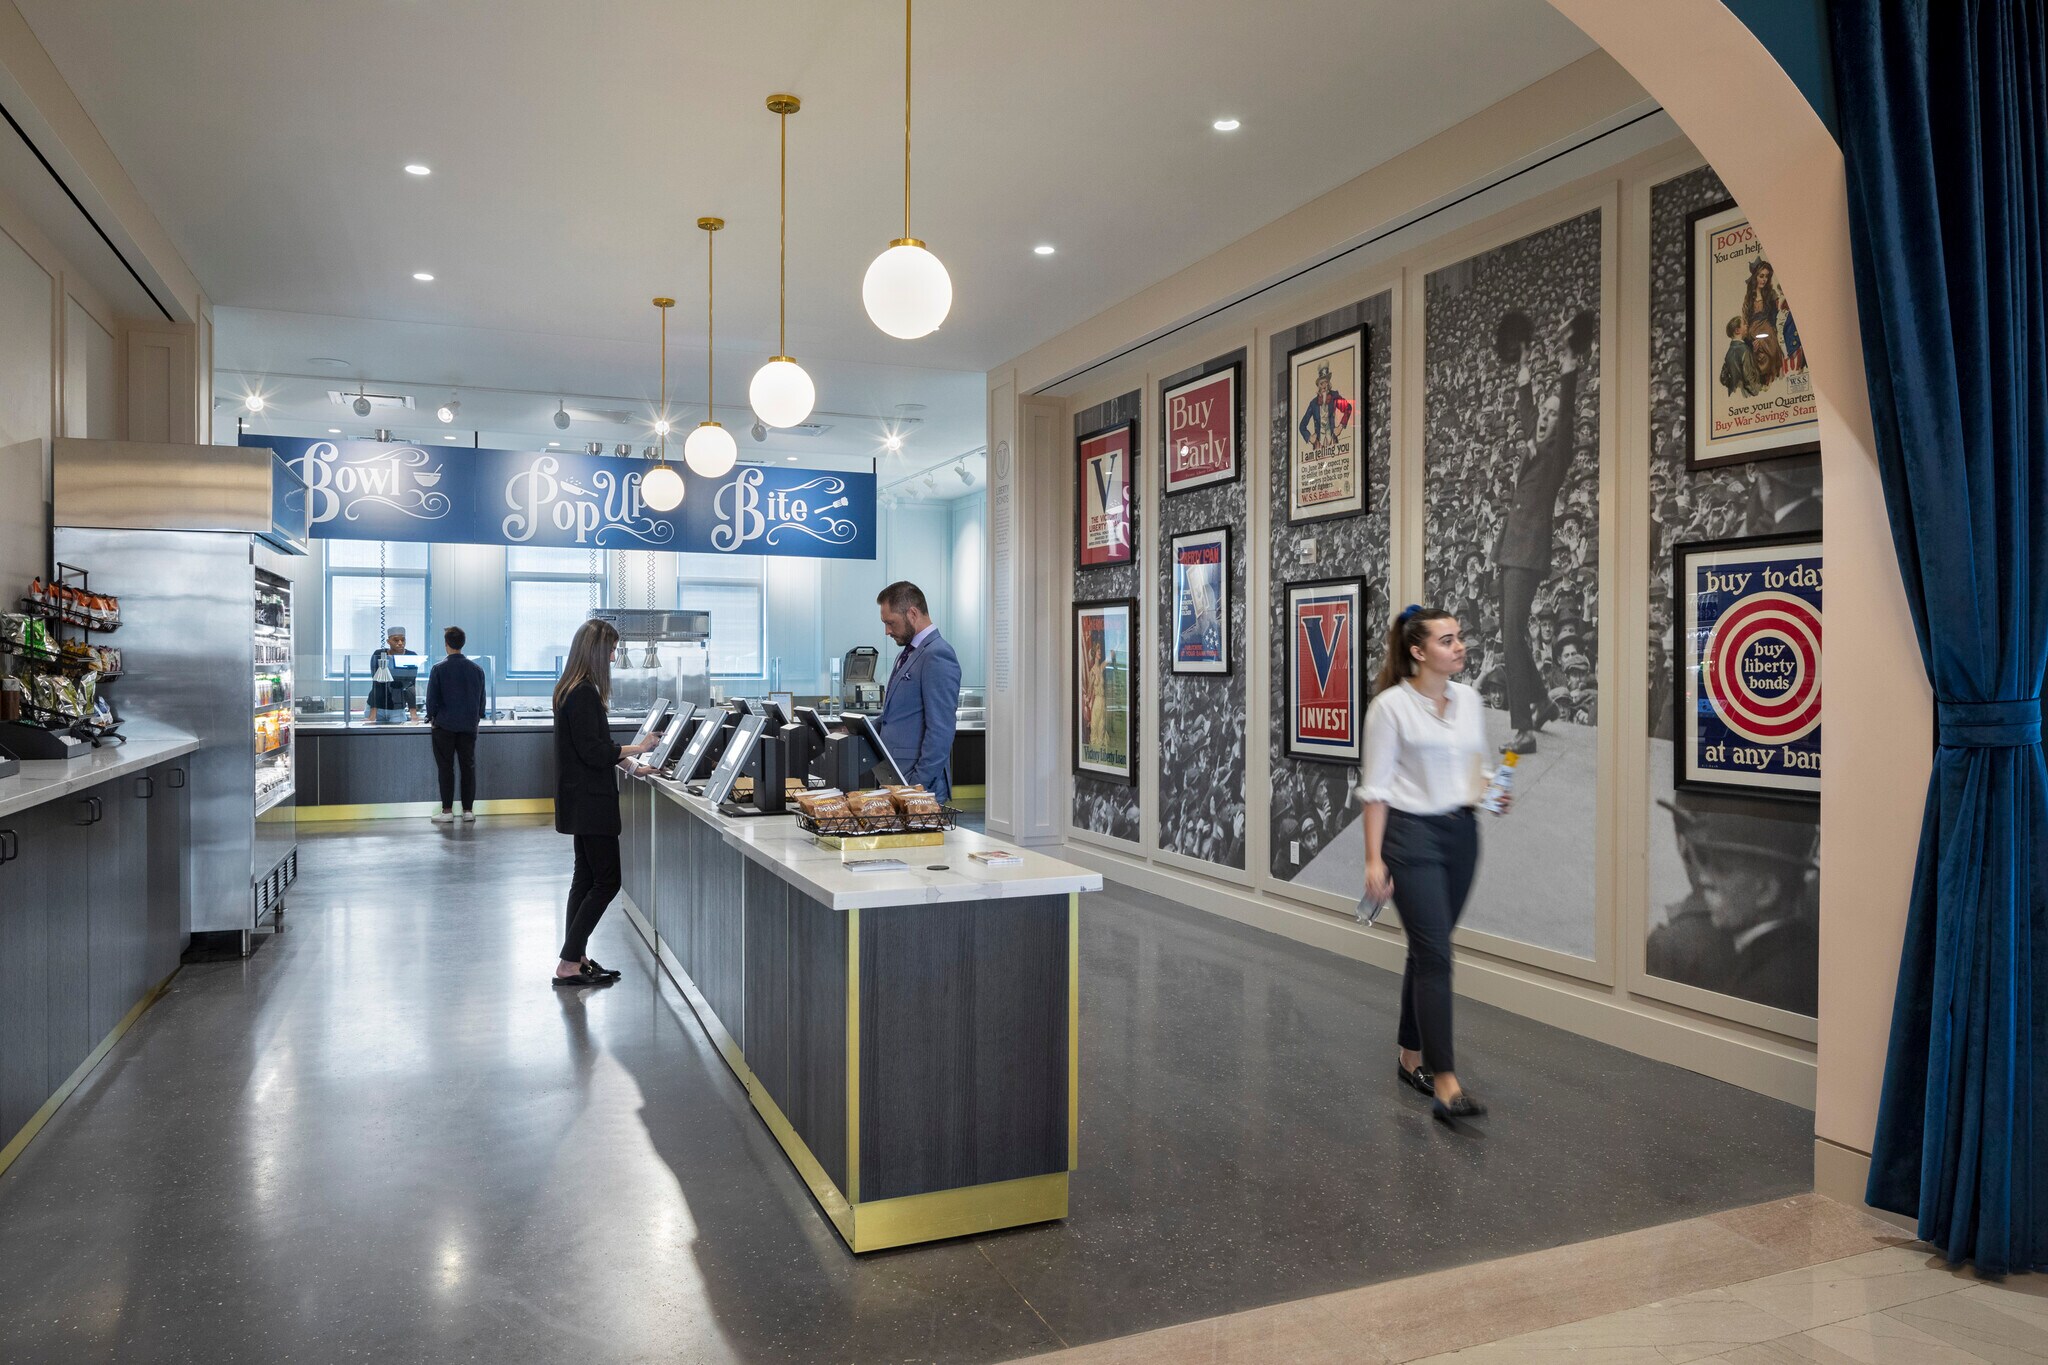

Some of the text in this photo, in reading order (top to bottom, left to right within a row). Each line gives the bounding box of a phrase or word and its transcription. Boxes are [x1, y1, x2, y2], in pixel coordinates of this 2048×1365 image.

[1714, 252, 1729, 264] You
[1730, 249, 1744, 259] can
[1172, 396, 1215, 431] Buy
[1728, 393, 1815, 417] Save your Quarters
[1715, 420, 1733, 432] Buy
[1734, 416, 1753, 427] War
[1754, 410, 1789, 424] Savings
[1175, 429, 1227, 472] Early
[1305, 450, 1314, 461] am
[1315, 445, 1336, 461] telling
[1337, 443, 1349, 456] you
[1331, 466, 1342, 474] army
[286, 442, 401, 529] Bowl
[1091, 453, 1118, 514] V
[502, 456, 601, 543] Pop
[711, 468, 808, 552] Bite
[1091, 515, 1099, 524] THE
[1203, 547, 1219, 564] LOAN
[1706, 571, 1752, 595] buy
[1301, 613, 1346, 698] V
[1754, 642, 1786, 659] buy
[1744, 658, 1796, 676] liberty
[1749, 676, 1790, 690] bonds
[1302, 707, 1347, 731] INVEST
[1084, 746, 1127, 765] Victory Liberty Loan
[1705, 741, 1726, 762] at
[1733, 747, 1776, 770] any
